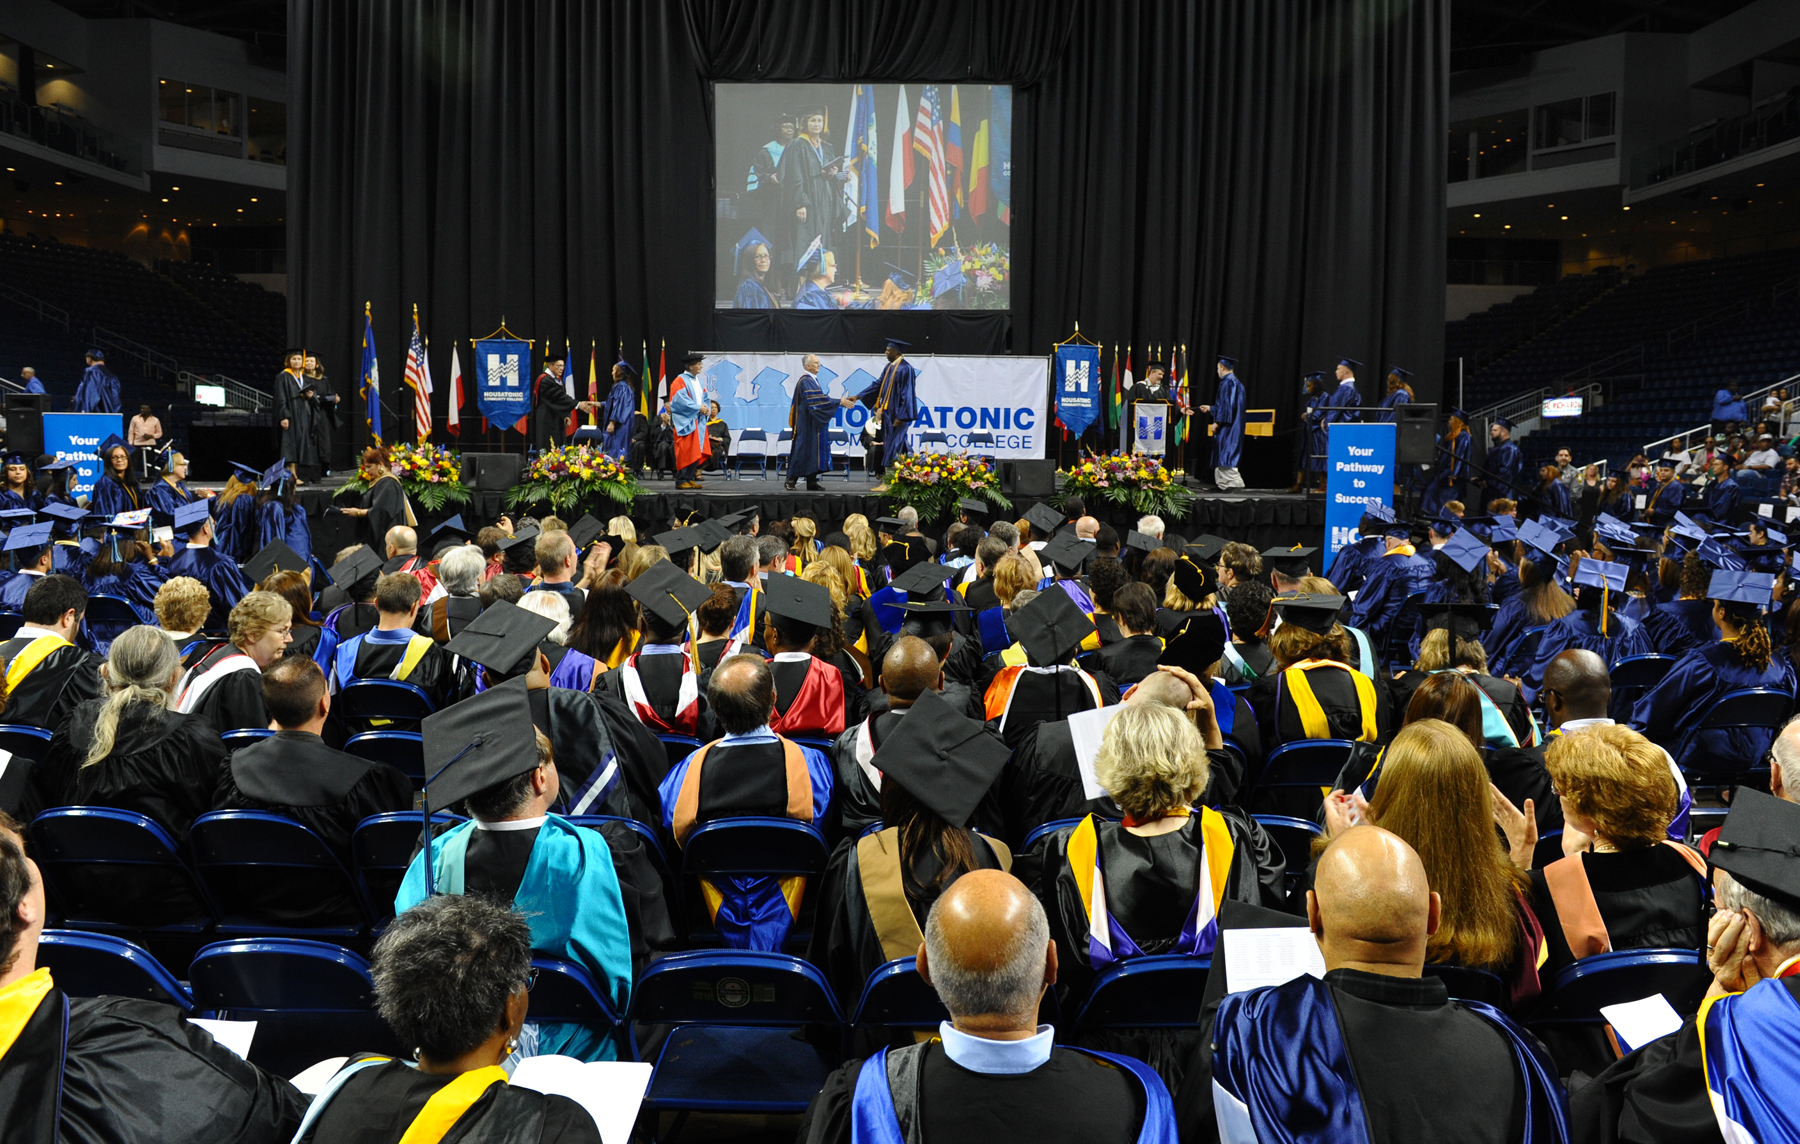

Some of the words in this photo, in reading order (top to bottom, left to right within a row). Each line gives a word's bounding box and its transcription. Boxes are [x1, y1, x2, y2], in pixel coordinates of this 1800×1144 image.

[487, 354, 519, 386] H
[1064, 360, 1090, 392] H
[832, 405, 1035, 430] HOATONIC
[68, 435, 100, 446] Your
[56, 450, 103, 461] Pathw
[1347, 446, 1374, 456] Your
[78, 467, 93, 477] to
[1336, 462, 1385, 475] Pathway
[1352, 478, 1366, 488] to
